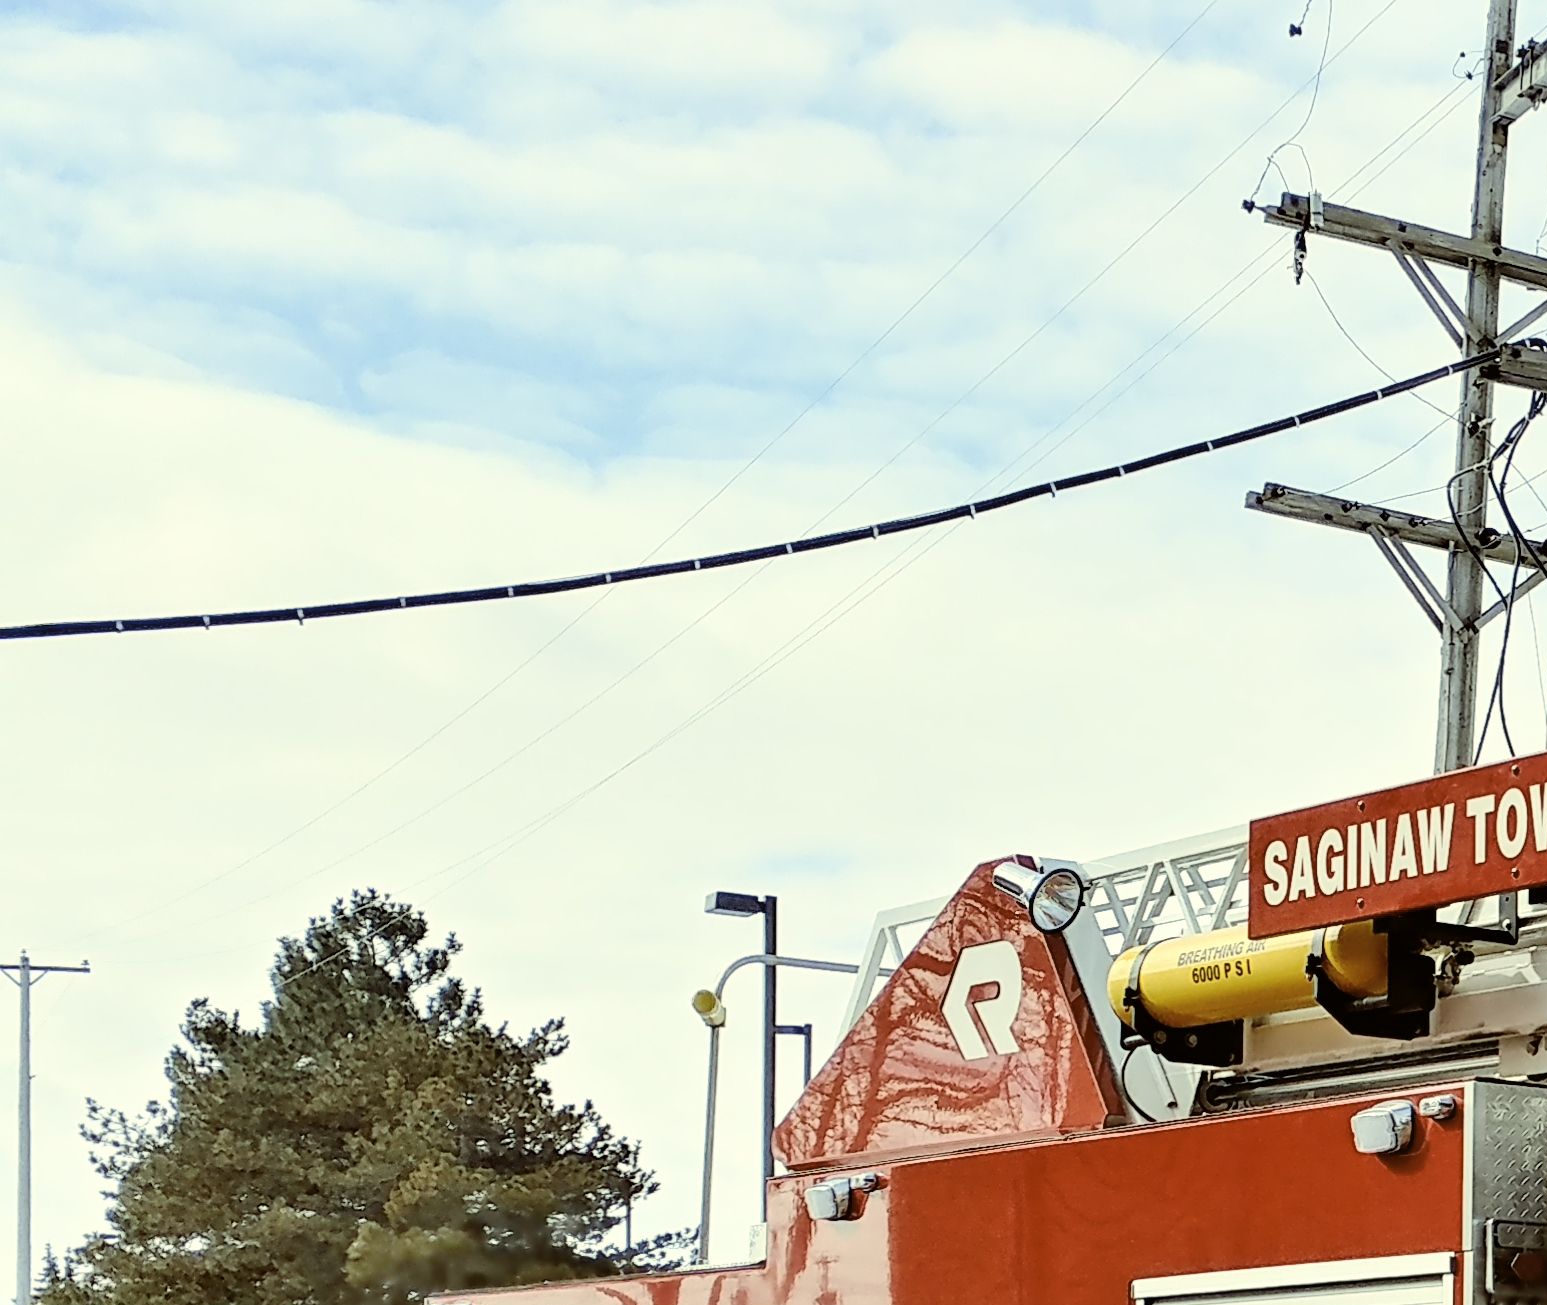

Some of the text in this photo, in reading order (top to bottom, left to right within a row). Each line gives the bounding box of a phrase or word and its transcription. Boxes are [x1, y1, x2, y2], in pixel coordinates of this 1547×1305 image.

[1263, 802, 1455, 906] SAGINAW
[1177, 941, 1244, 967] BREATHING
[1192, 963, 1221, 984] 6000
